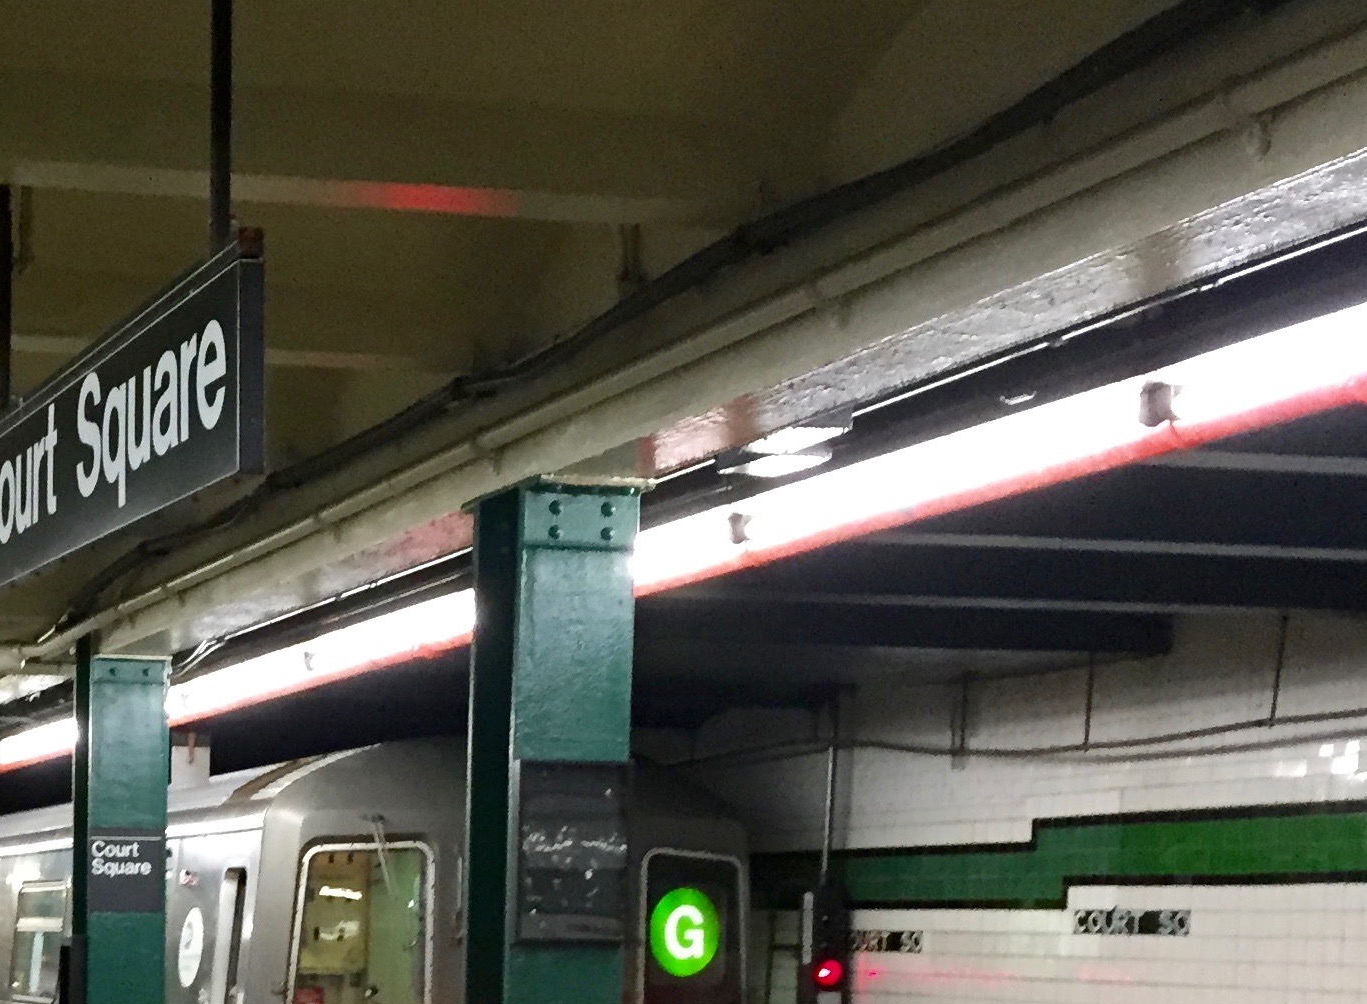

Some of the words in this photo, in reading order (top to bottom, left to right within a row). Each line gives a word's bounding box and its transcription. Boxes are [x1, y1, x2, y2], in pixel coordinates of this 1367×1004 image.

[76, 319, 227, 509] Square
[91, 840, 140, 858] Court
[91, 857, 152, 878] Square
[664, 904, 706, 960] G
